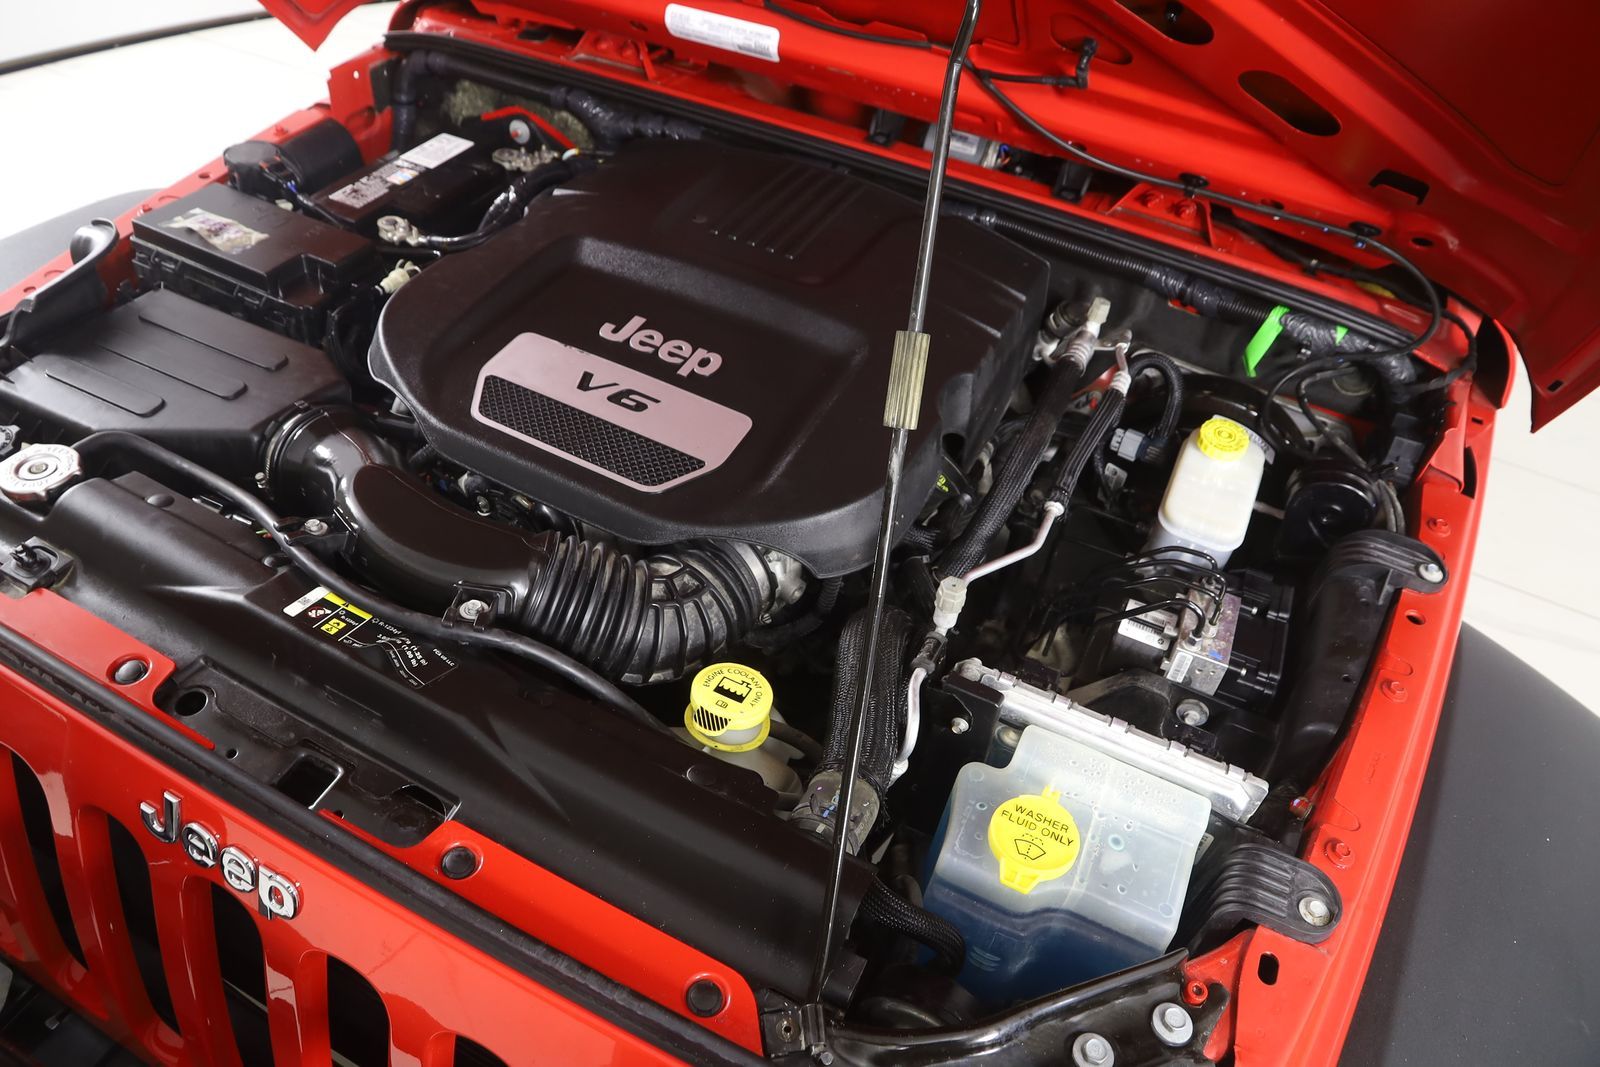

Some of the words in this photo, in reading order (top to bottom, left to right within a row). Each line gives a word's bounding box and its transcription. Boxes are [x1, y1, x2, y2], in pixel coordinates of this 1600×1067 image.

[599, 315, 722, 378] Jeep
[577, 371, 661, 412] V6
[703, 669, 725, 688] ENGINE
[727, 668, 762, 689] COOLANT
[750, 691, 763, 708] ONLY
[1001, 809, 1037, 831] FLUID
[1041, 827, 1074, 847] ONLY
[1015, 804, 1069, 833] WASHER
[140, 790, 299, 920] Jeep
